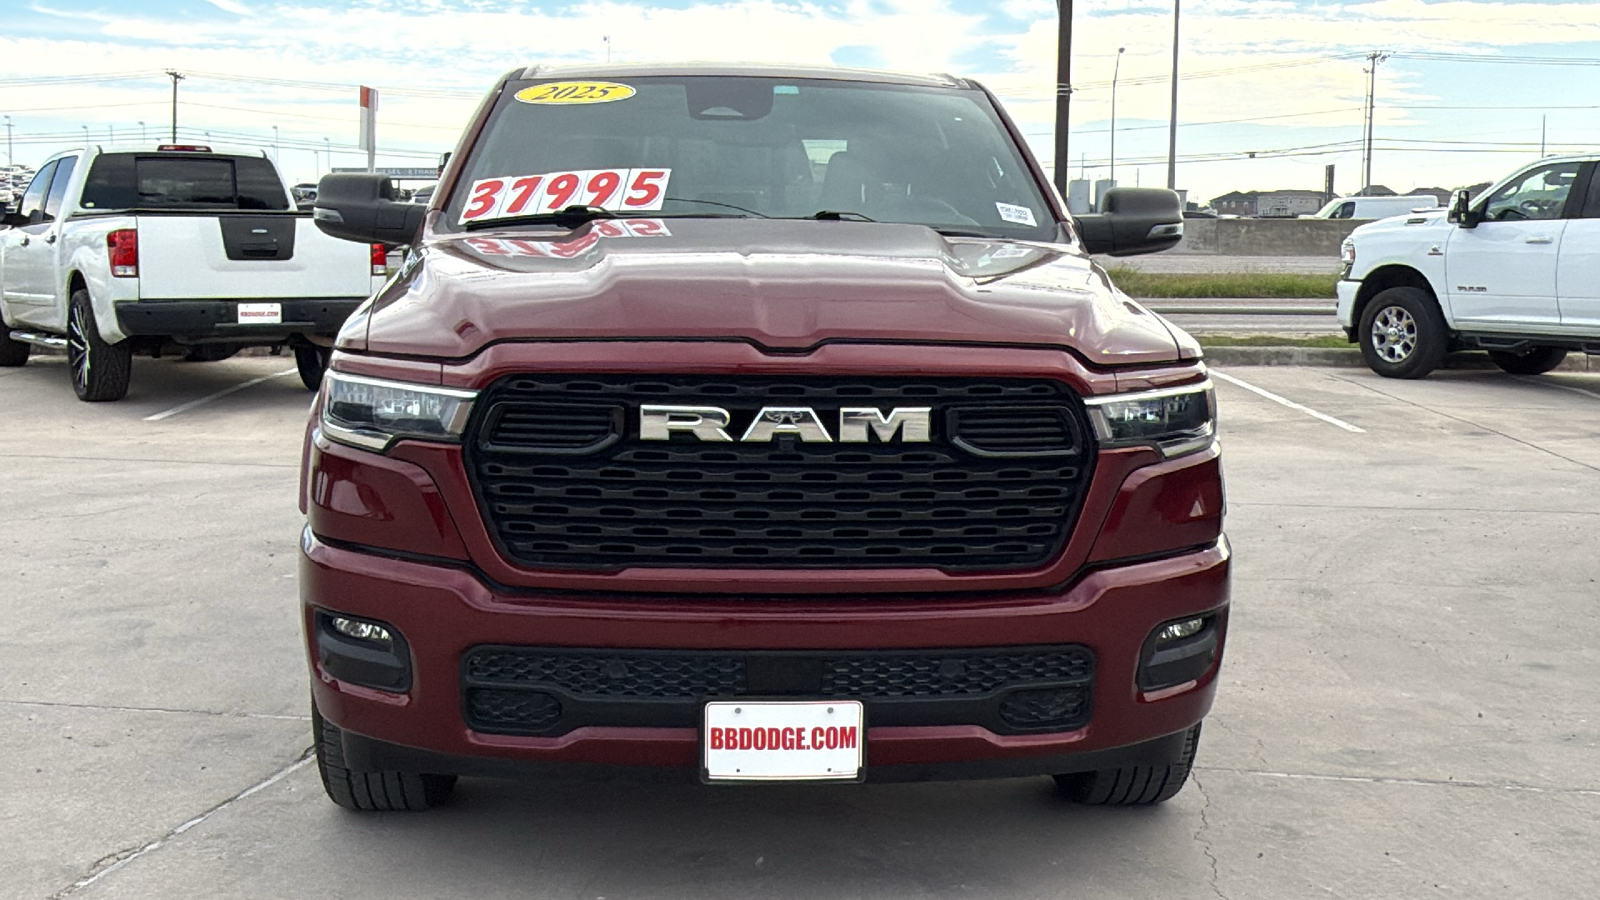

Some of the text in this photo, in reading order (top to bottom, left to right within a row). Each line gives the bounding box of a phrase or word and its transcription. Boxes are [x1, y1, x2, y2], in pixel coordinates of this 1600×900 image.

[531, 86, 619, 101] 2025
[462, 171, 667, 220] 37995
[640, 404, 932, 442] RAM
[710, 726, 857, 751] BBDODGE.COM
